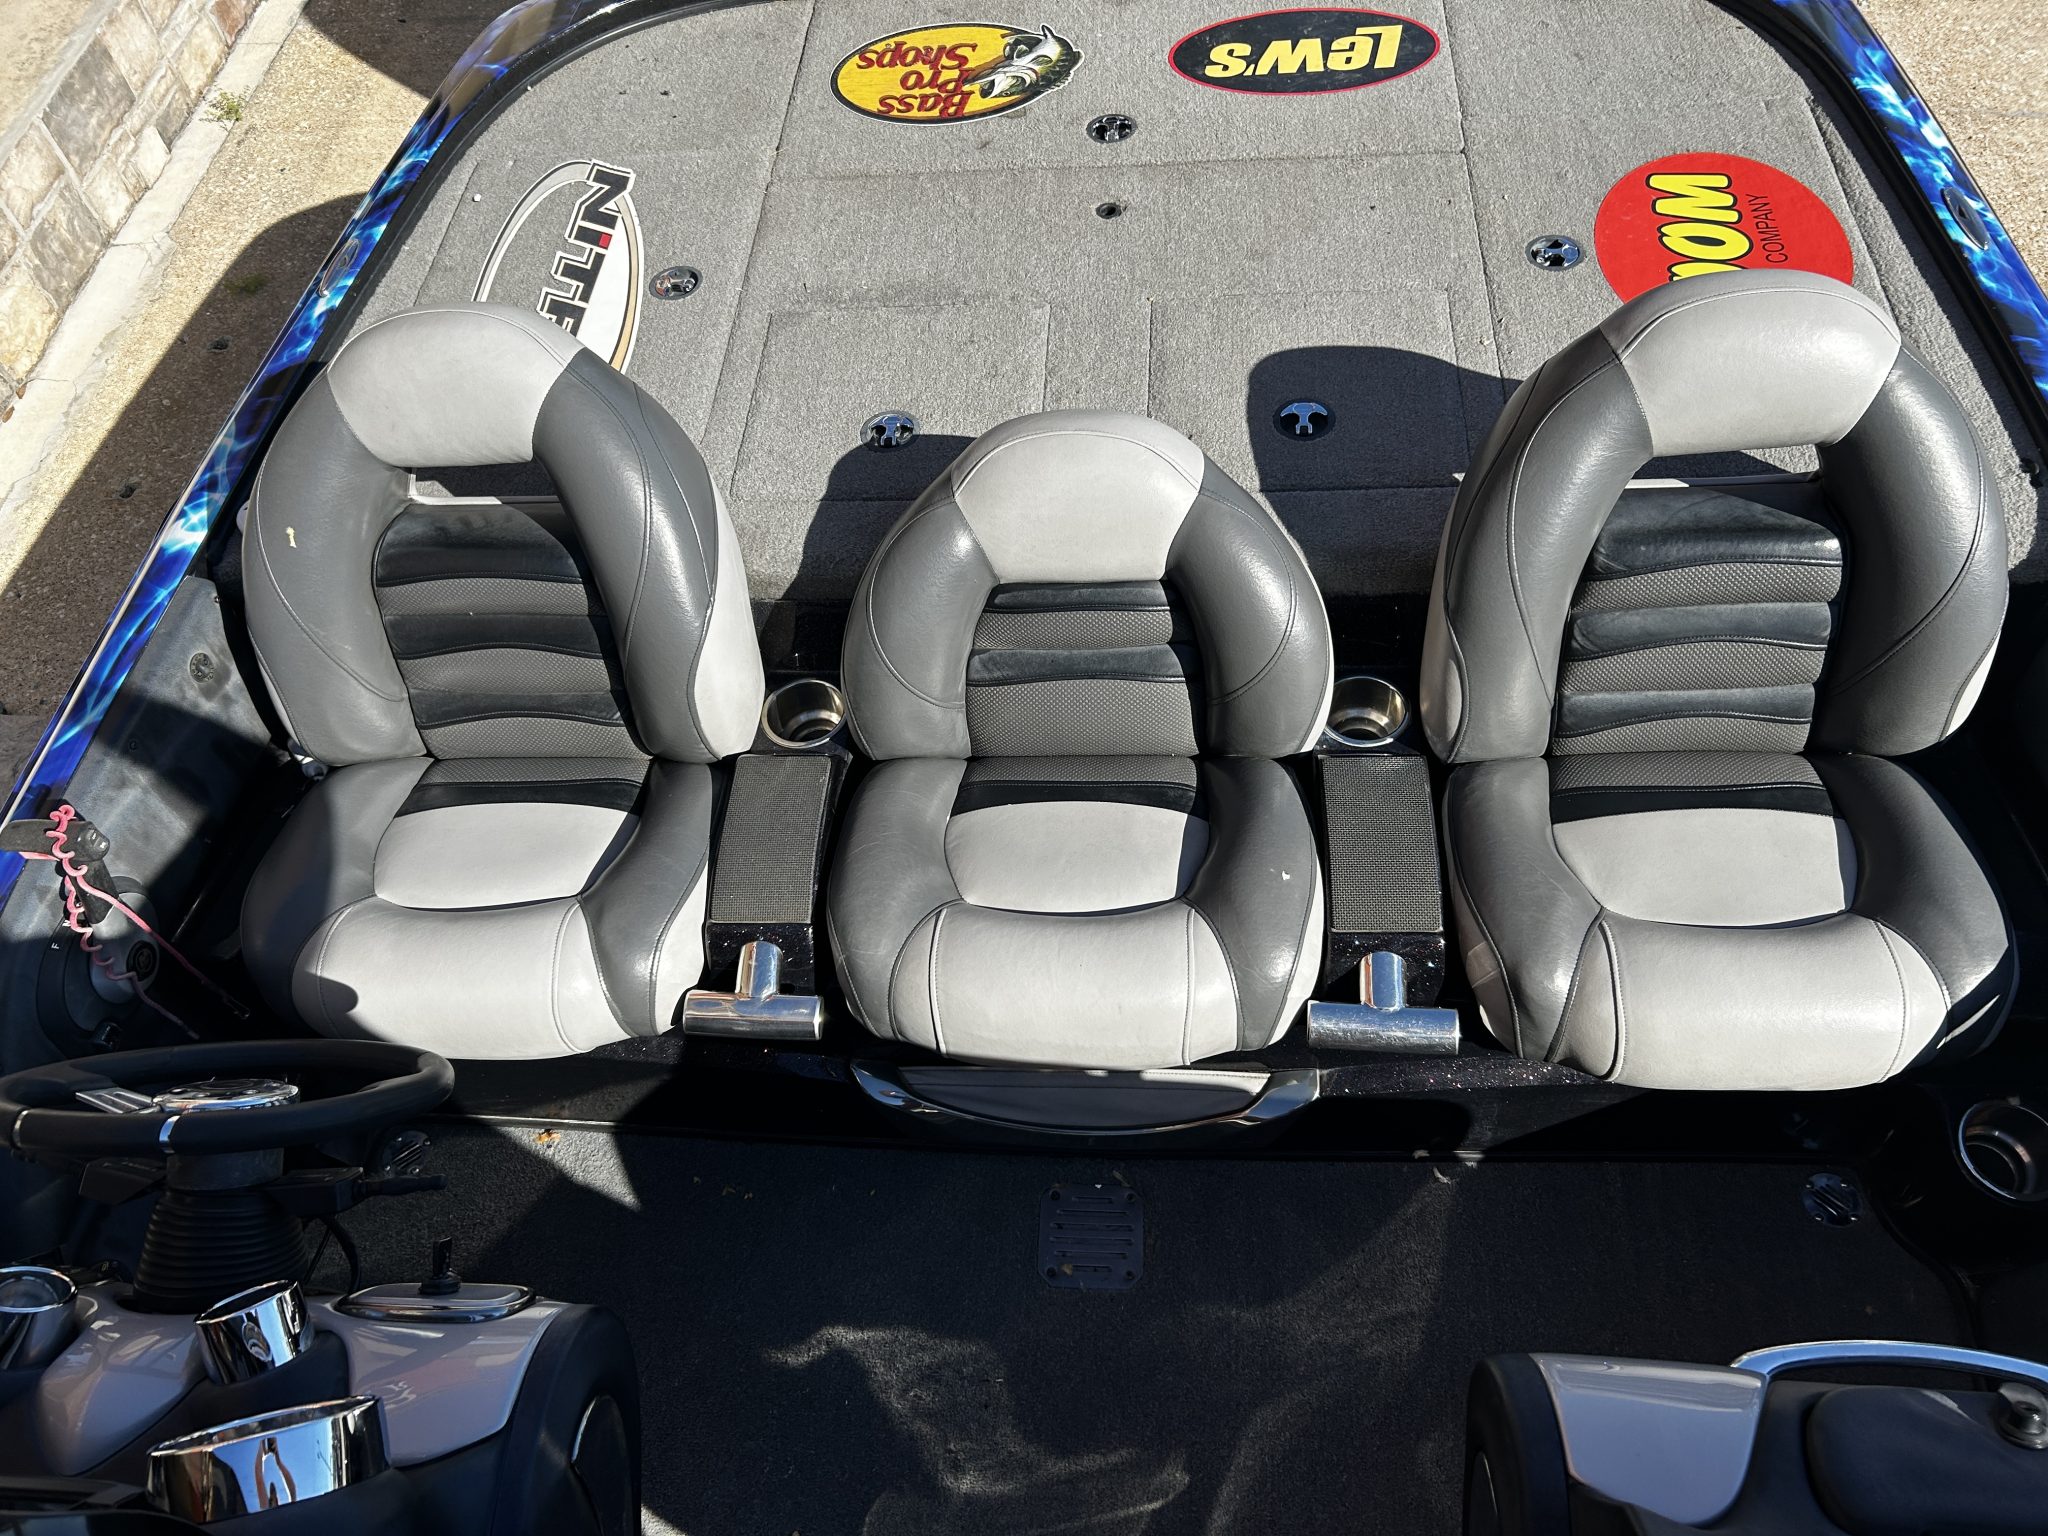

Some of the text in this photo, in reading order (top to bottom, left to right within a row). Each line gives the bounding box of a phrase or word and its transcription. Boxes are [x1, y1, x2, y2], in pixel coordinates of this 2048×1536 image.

[856, 41, 978, 70] Shops
[1204, 24, 1403, 78] Lew's
[899, 67, 976, 94] Pro
[877, 90, 976, 118] Bass
[1746, 193, 1789, 263] COMPANY
[51, 942, 60, 950] F
